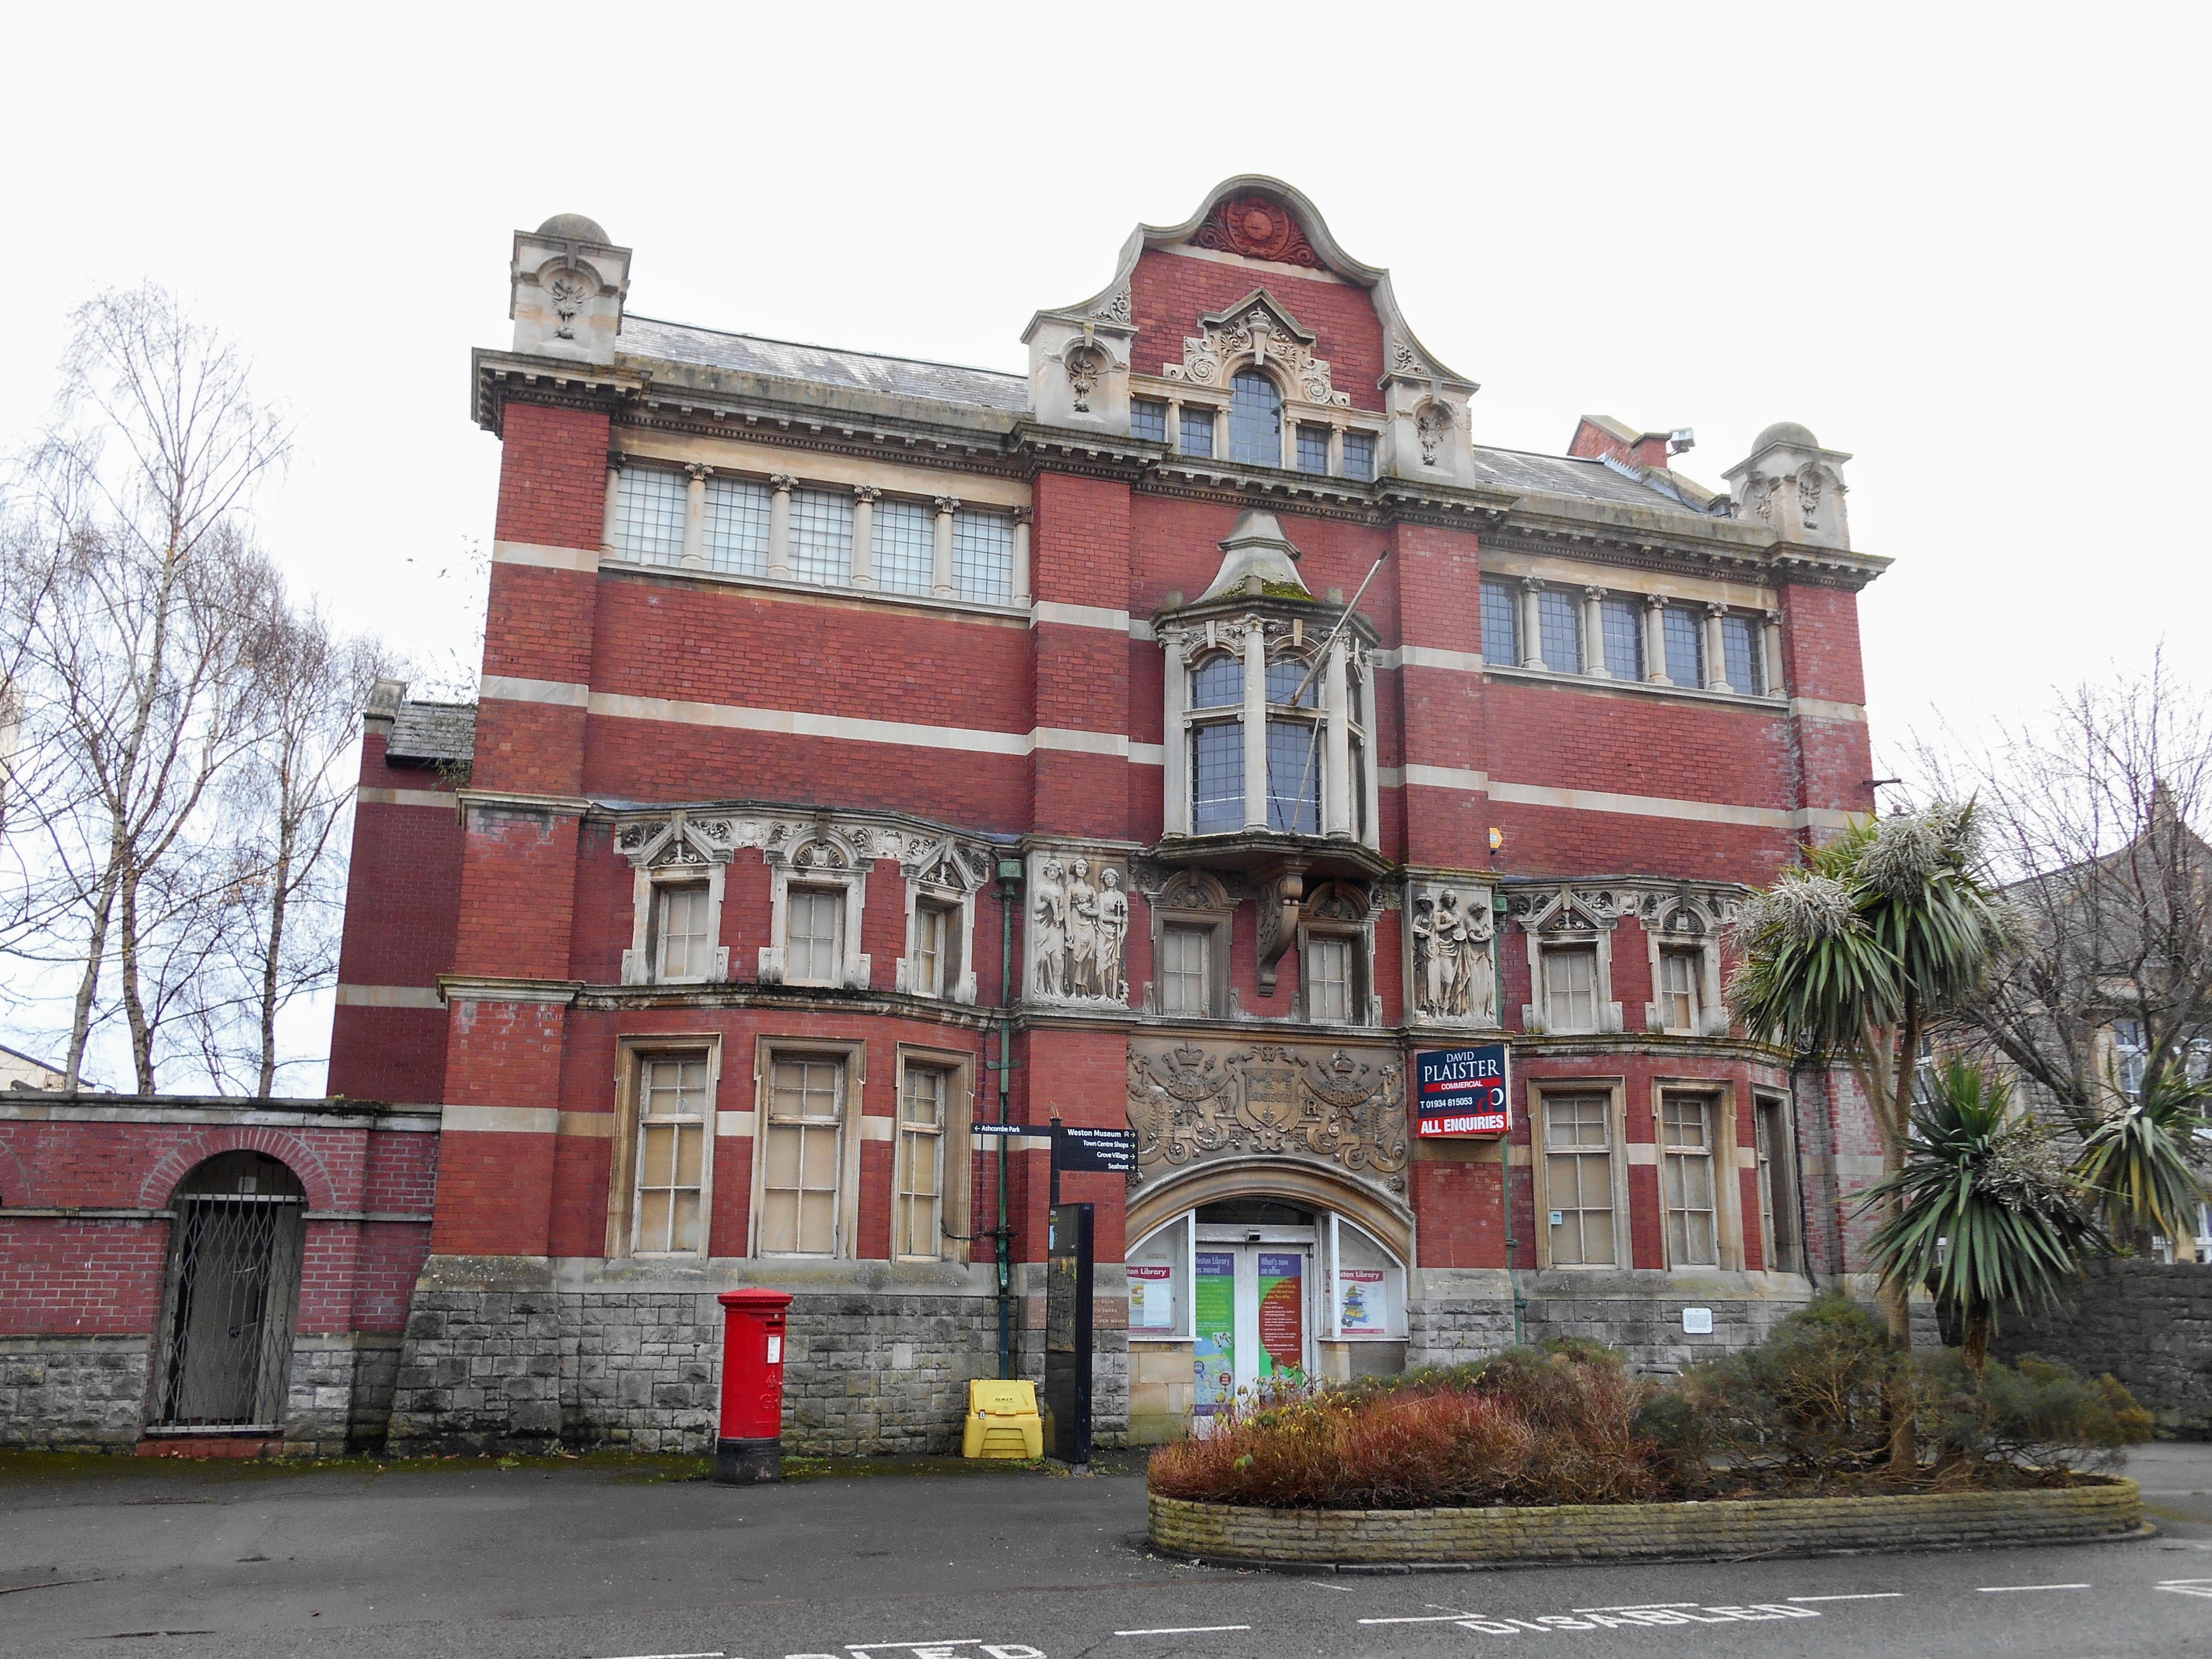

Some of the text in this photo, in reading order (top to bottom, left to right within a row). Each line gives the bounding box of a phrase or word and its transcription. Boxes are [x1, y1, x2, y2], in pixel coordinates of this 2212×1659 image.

[1447, 1051, 1474, 1063] DAVID
[1424, 1059, 1500, 1082] PLAISTER
[1165, 1079, 1218, 1098] PUBLIC
[1441, 1080, 1482, 1090] COMMERCIAL
[1426, 1099, 1446, 1108] 01934
[1448, 1097, 1472, 1106] 815053
[1421, 1114, 1504, 1134] ALL ENQUIRIES
[1094, 1129, 1121, 1137] Museum
[1111, 1152, 1129, 1160] Village
[1212, 1256, 1230, 1266] Library
[1140, 1268, 1166, 1276] Library
[1203, 1265, 1220, 1273] moved
[1268, 1266, 1280, 1274] offer
[1356, 1271, 1380, 1279] Library
[1455, 1604, 1821, 1634] DISABLED
